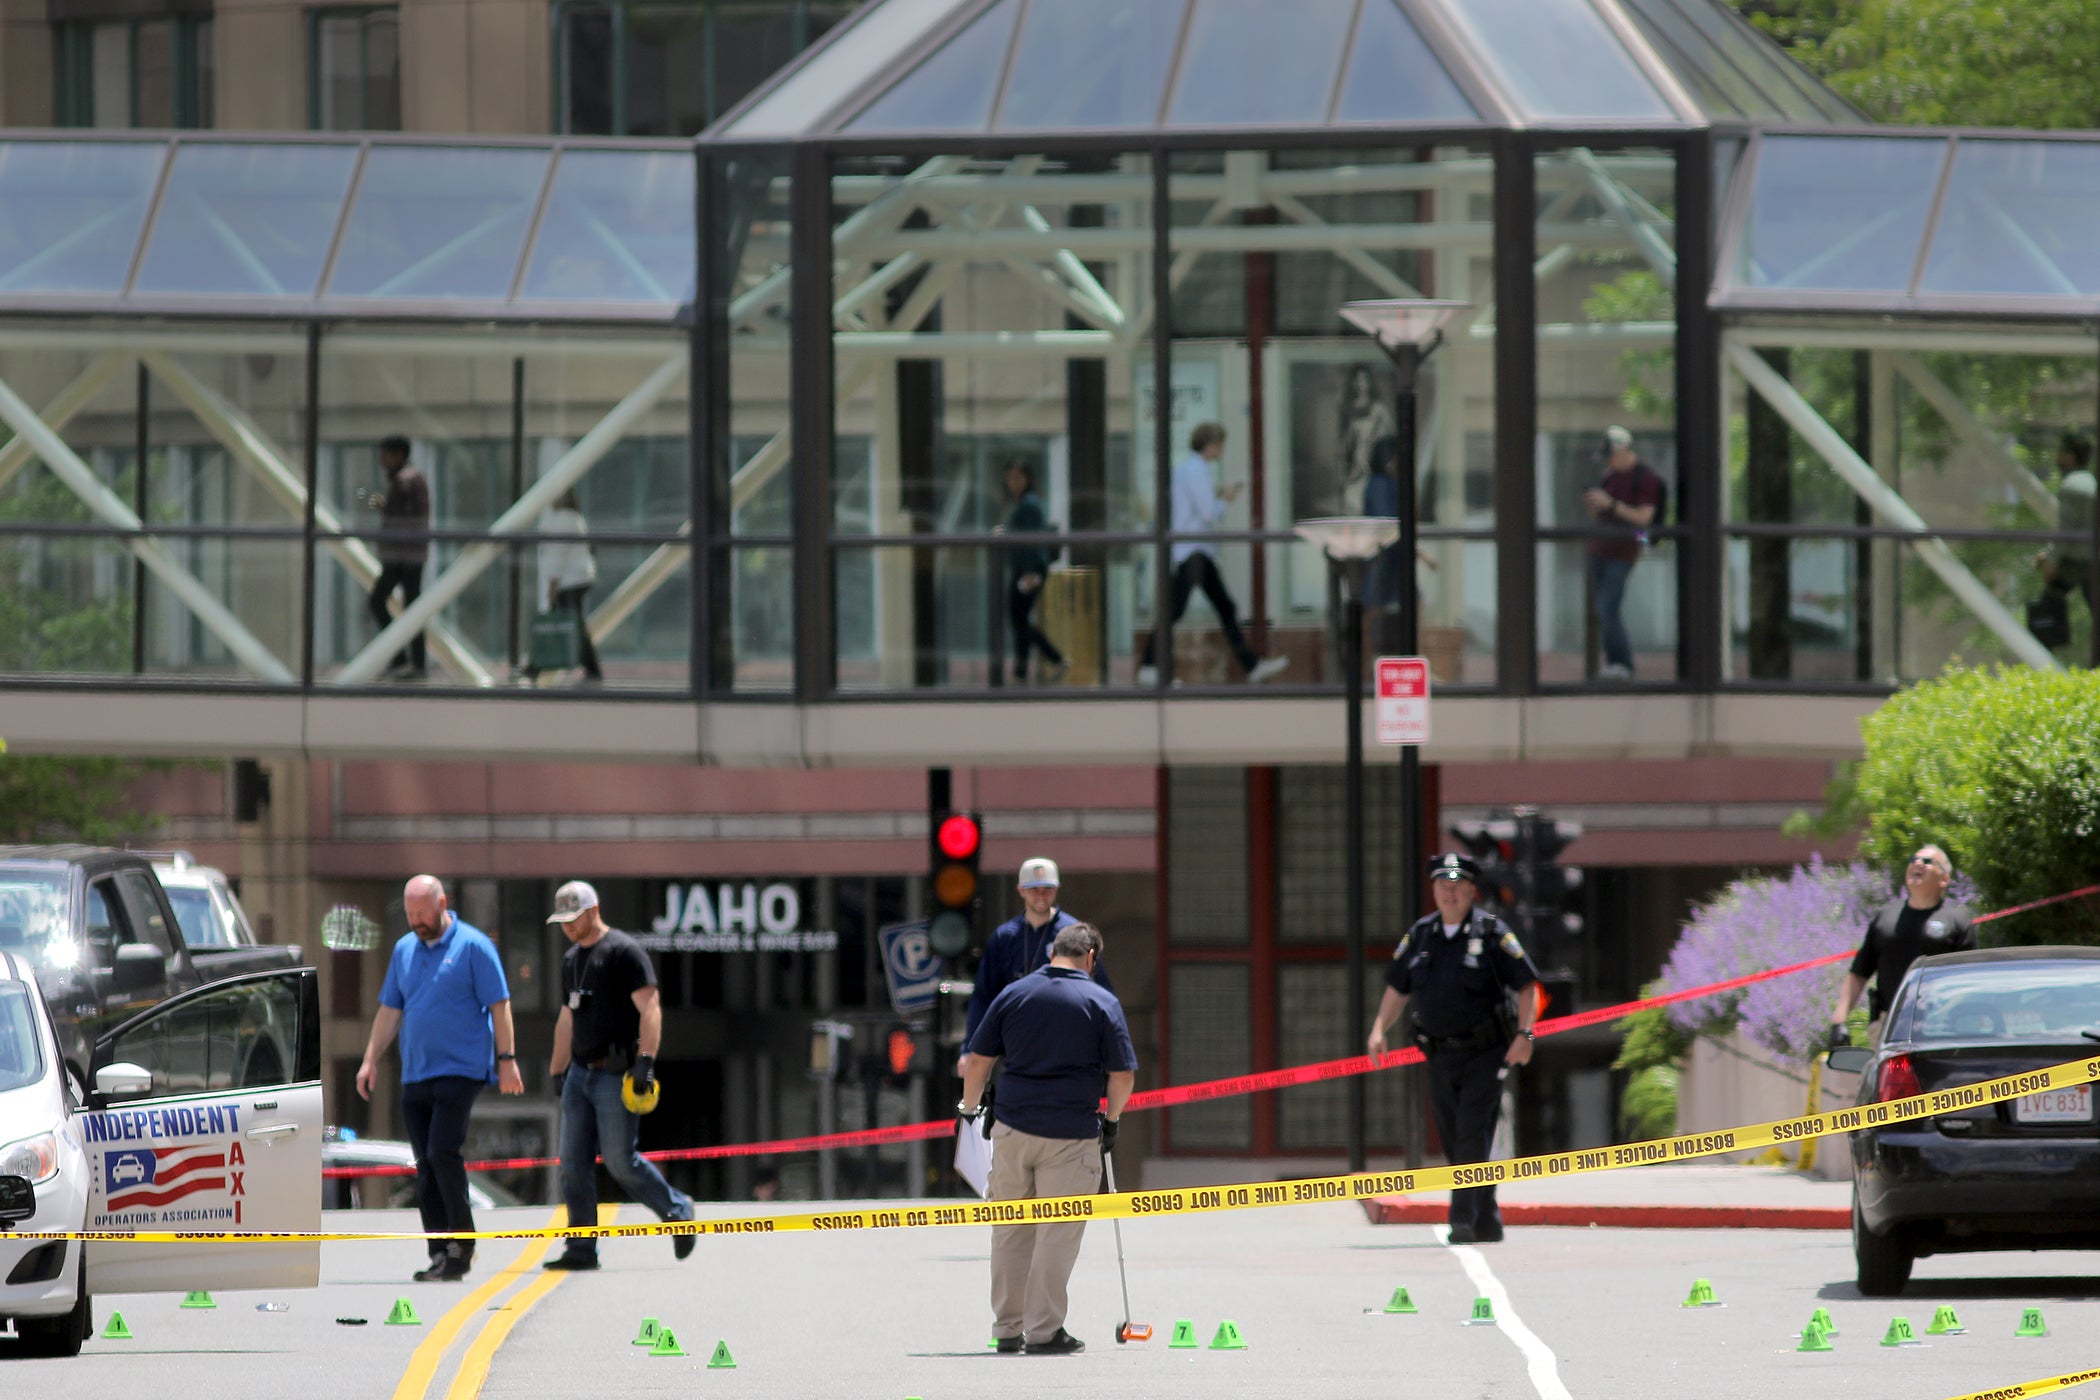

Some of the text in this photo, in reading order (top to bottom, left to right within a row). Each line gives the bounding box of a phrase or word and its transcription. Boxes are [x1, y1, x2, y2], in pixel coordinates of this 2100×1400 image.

[652, 883, 799, 933] JAHO
[1773, 1073, 2051, 1141] BOSTON POLICE LINE DO NOT CROSS
[2056, 1092, 2087, 1113] 831
[82, 1104, 241, 1143] INDEPENDENT
[1453, 1133, 1735, 1185] BOSTON POLICE LINE DO NOT CROSS
[1131, 1174, 1415, 1213] BOSTON POLICE LINE DO NOT CROSS
[94, 1208, 233, 1226] OPERATORS ASSOCIATION
[813, 1199, 1093, 1231] BOSTON POLICE LINE DO NOT CROSS
[1475, 1304, 1490, 1318] 19
[645, 1323, 653, 1338] 4
[1898, 1323, 1912, 1338] 12
[2024, 1314, 2039, 1329] 13
[668, 1336, 675, 1348] 5
[1178, 1326, 1187, 1340] 7
[719, 1348, 725, 1359] 9
